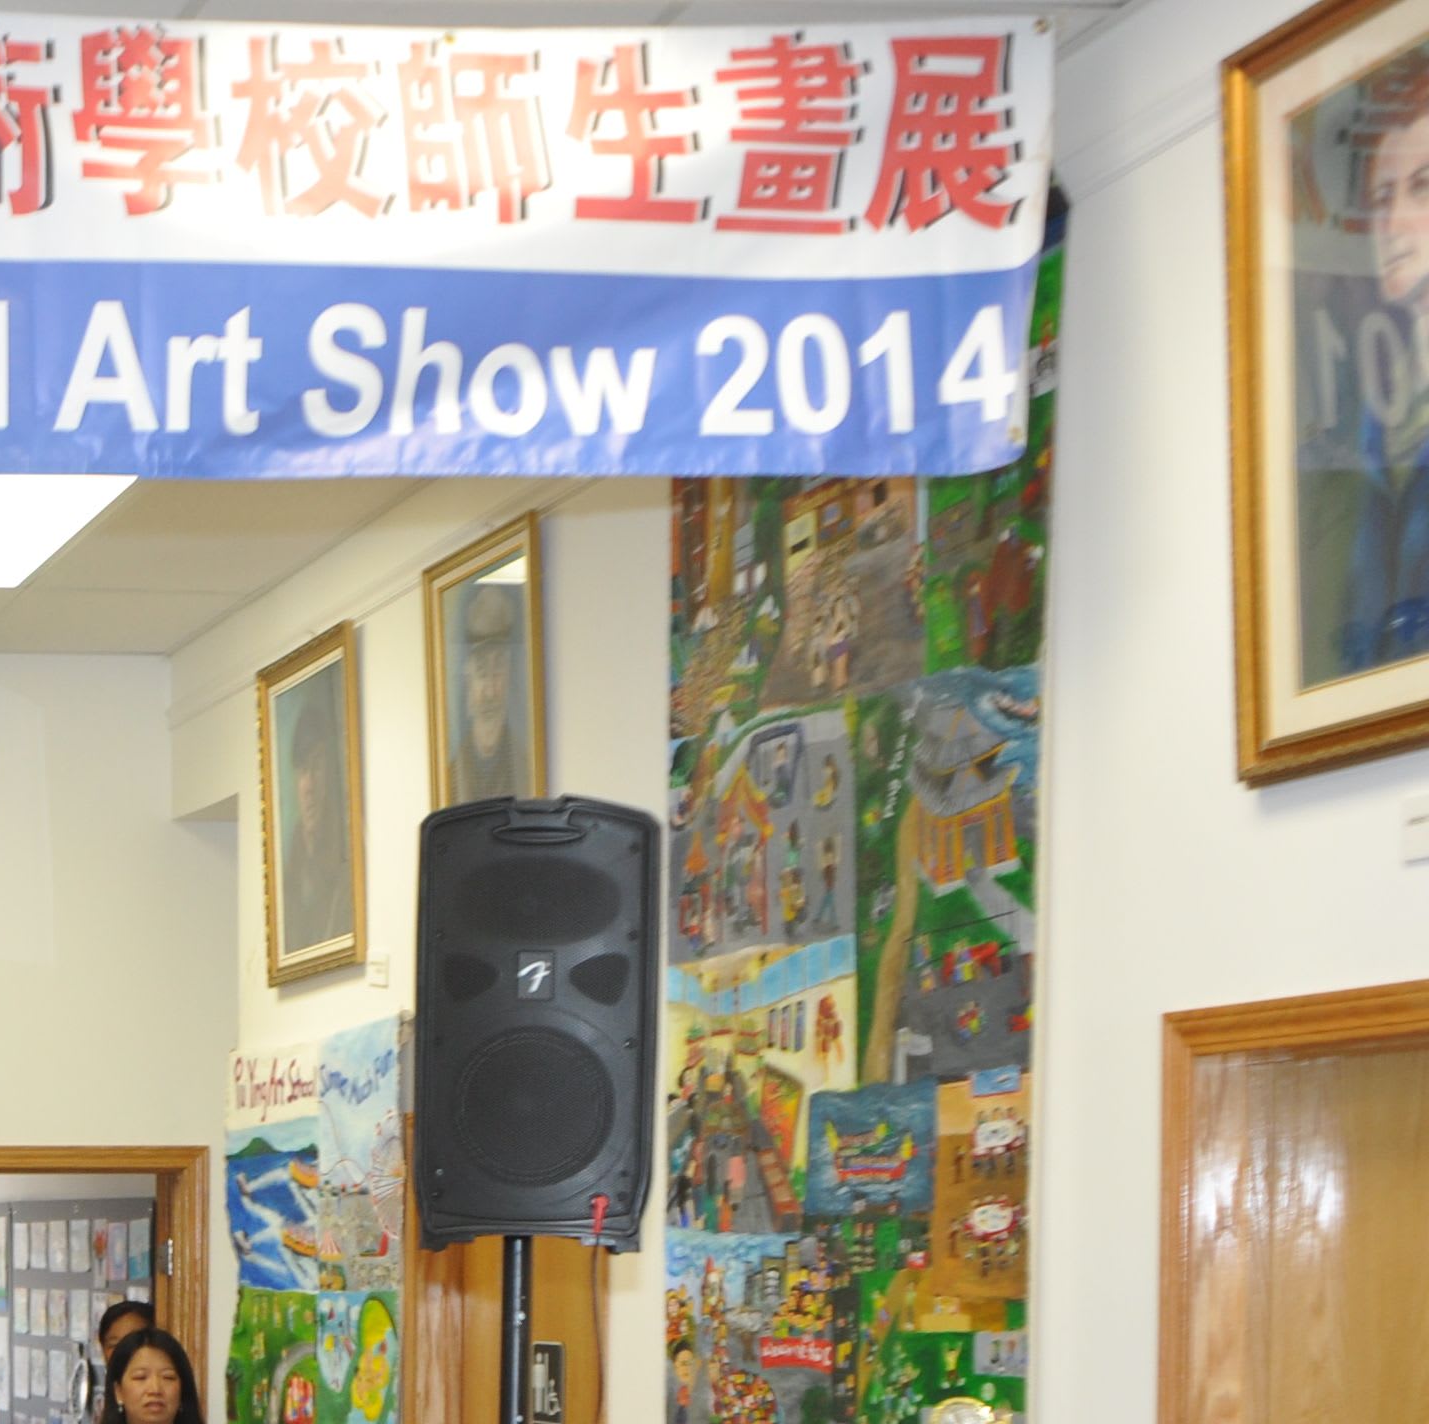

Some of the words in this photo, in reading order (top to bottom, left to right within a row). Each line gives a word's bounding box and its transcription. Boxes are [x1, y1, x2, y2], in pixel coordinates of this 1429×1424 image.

[53, 299, 262, 434] Art
[302, 301, 656, 437] Show
[697, 305, 1018, 437] 2014
